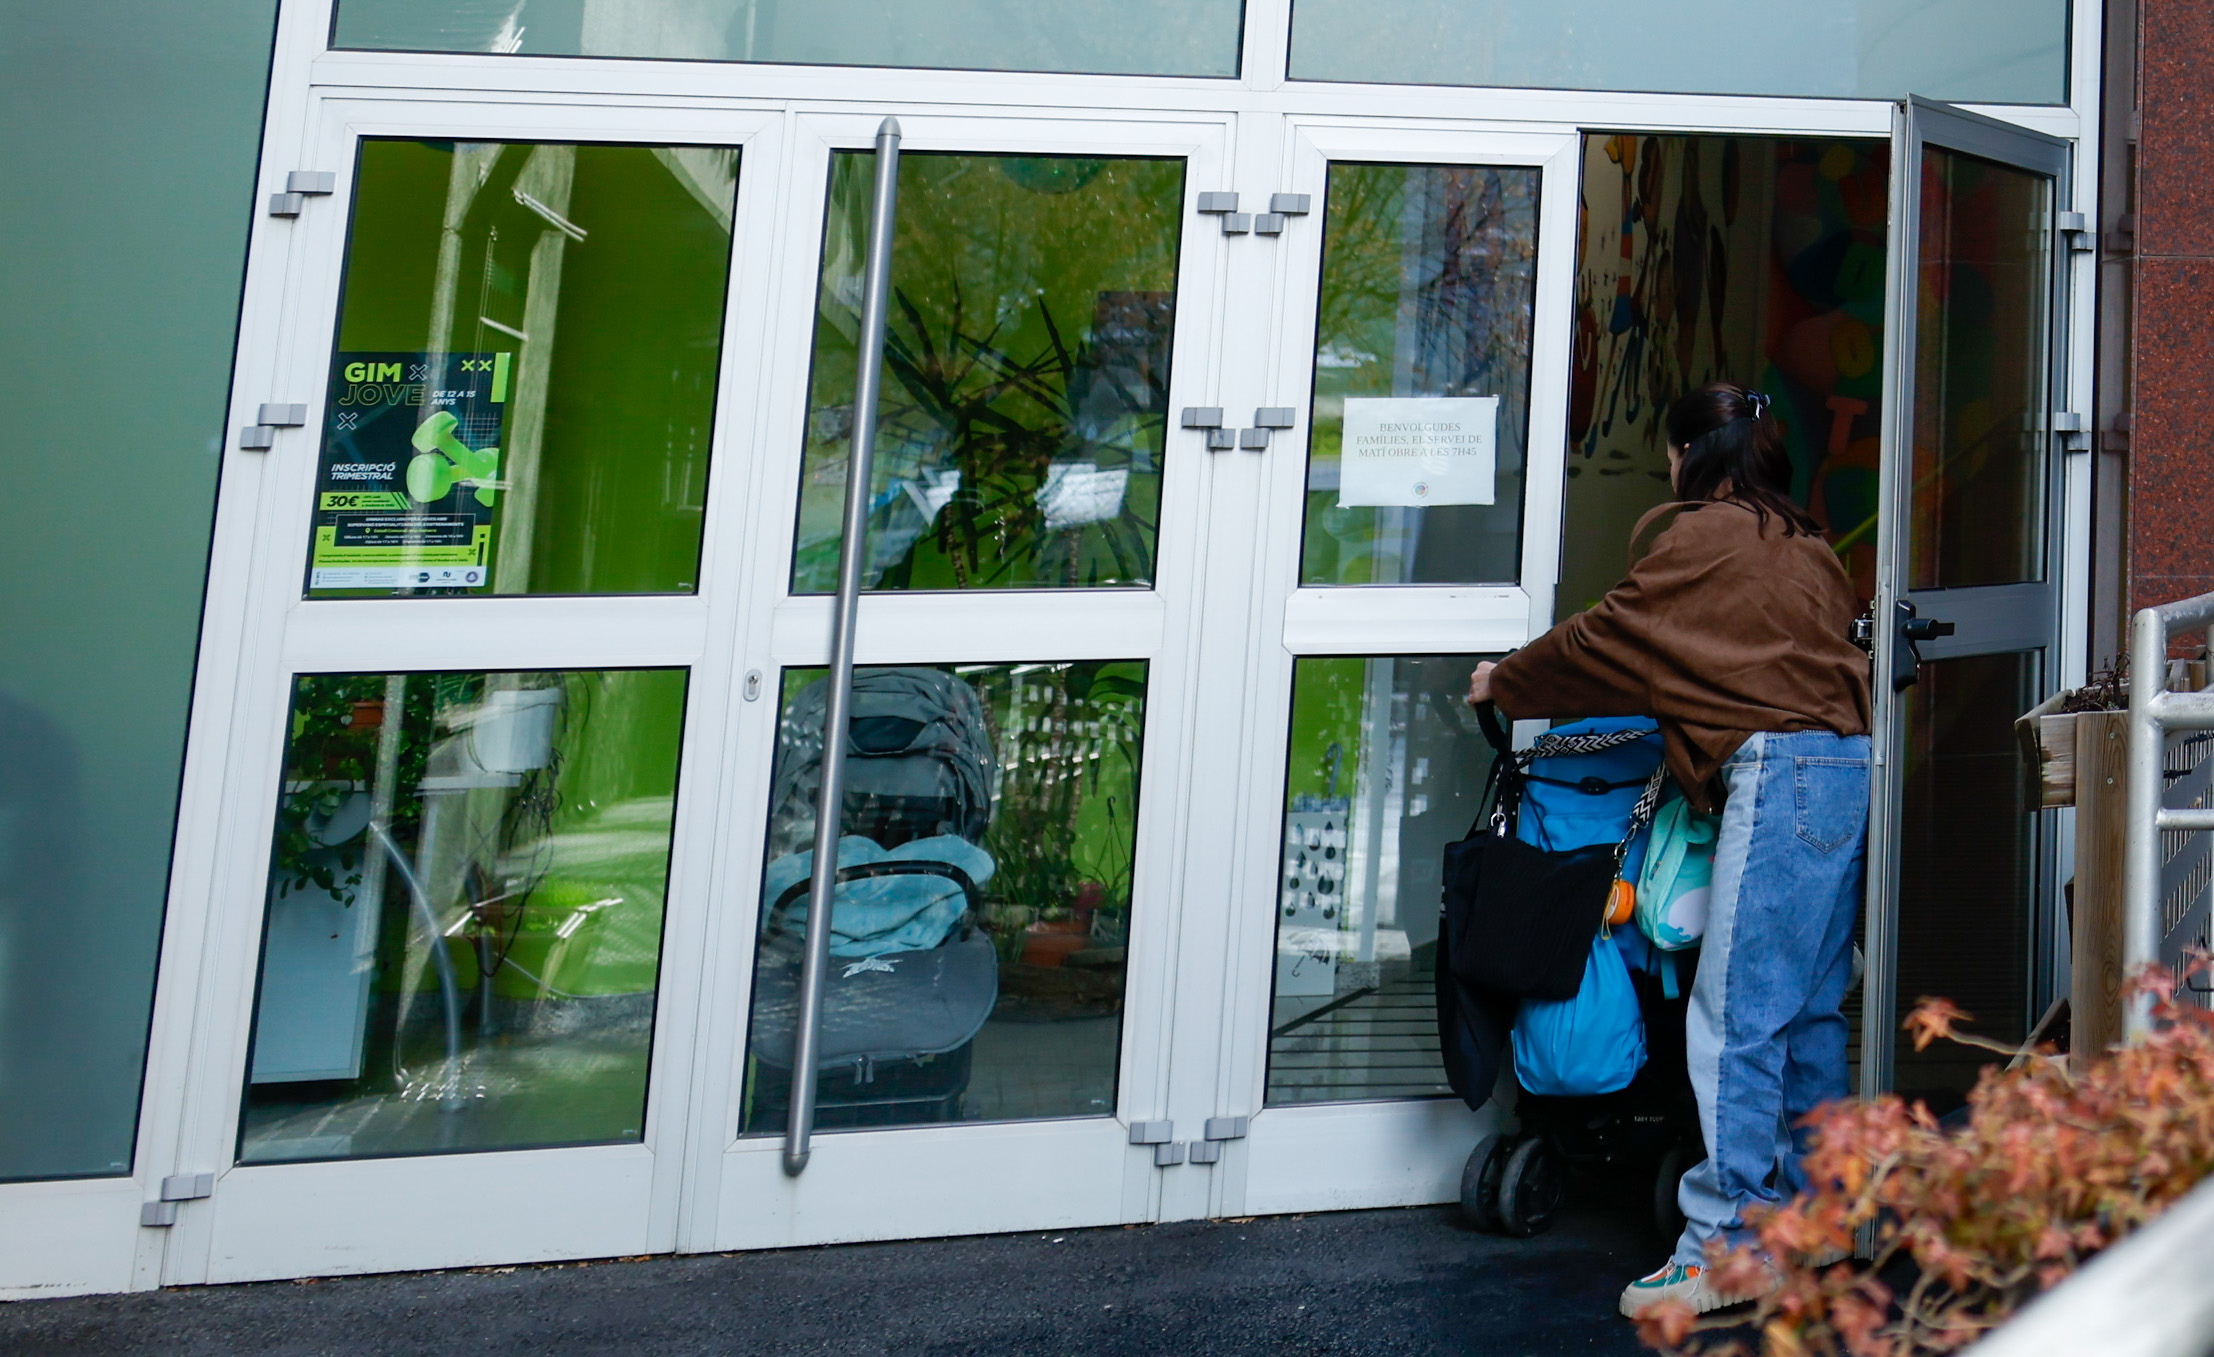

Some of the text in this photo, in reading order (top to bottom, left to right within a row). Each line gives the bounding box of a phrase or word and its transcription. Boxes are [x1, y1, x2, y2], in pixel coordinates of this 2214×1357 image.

[344, 362, 402, 383] GIM
[338, 384, 427, 406] JOVE
[432, 390, 476, 398] DE 12 A 15
[1379, 422, 1461, 432] BENVOLGUDES
[1356, 434, 1483, 445] FAMÍLIES, EL SERVEI DE
[1358, 446, 1386, 457] MATÍ
[1387, 447, 1418, 457] OBRE
[1430, 447, 1449, 456] LES
[1452, 447, 1477, 456] 7H45
[331, 462, 396, 472] INSCRIPCIÓ
[331, 472, 393, 480] TRIMESTRAL
[326, 495, 360, 507] 30€
